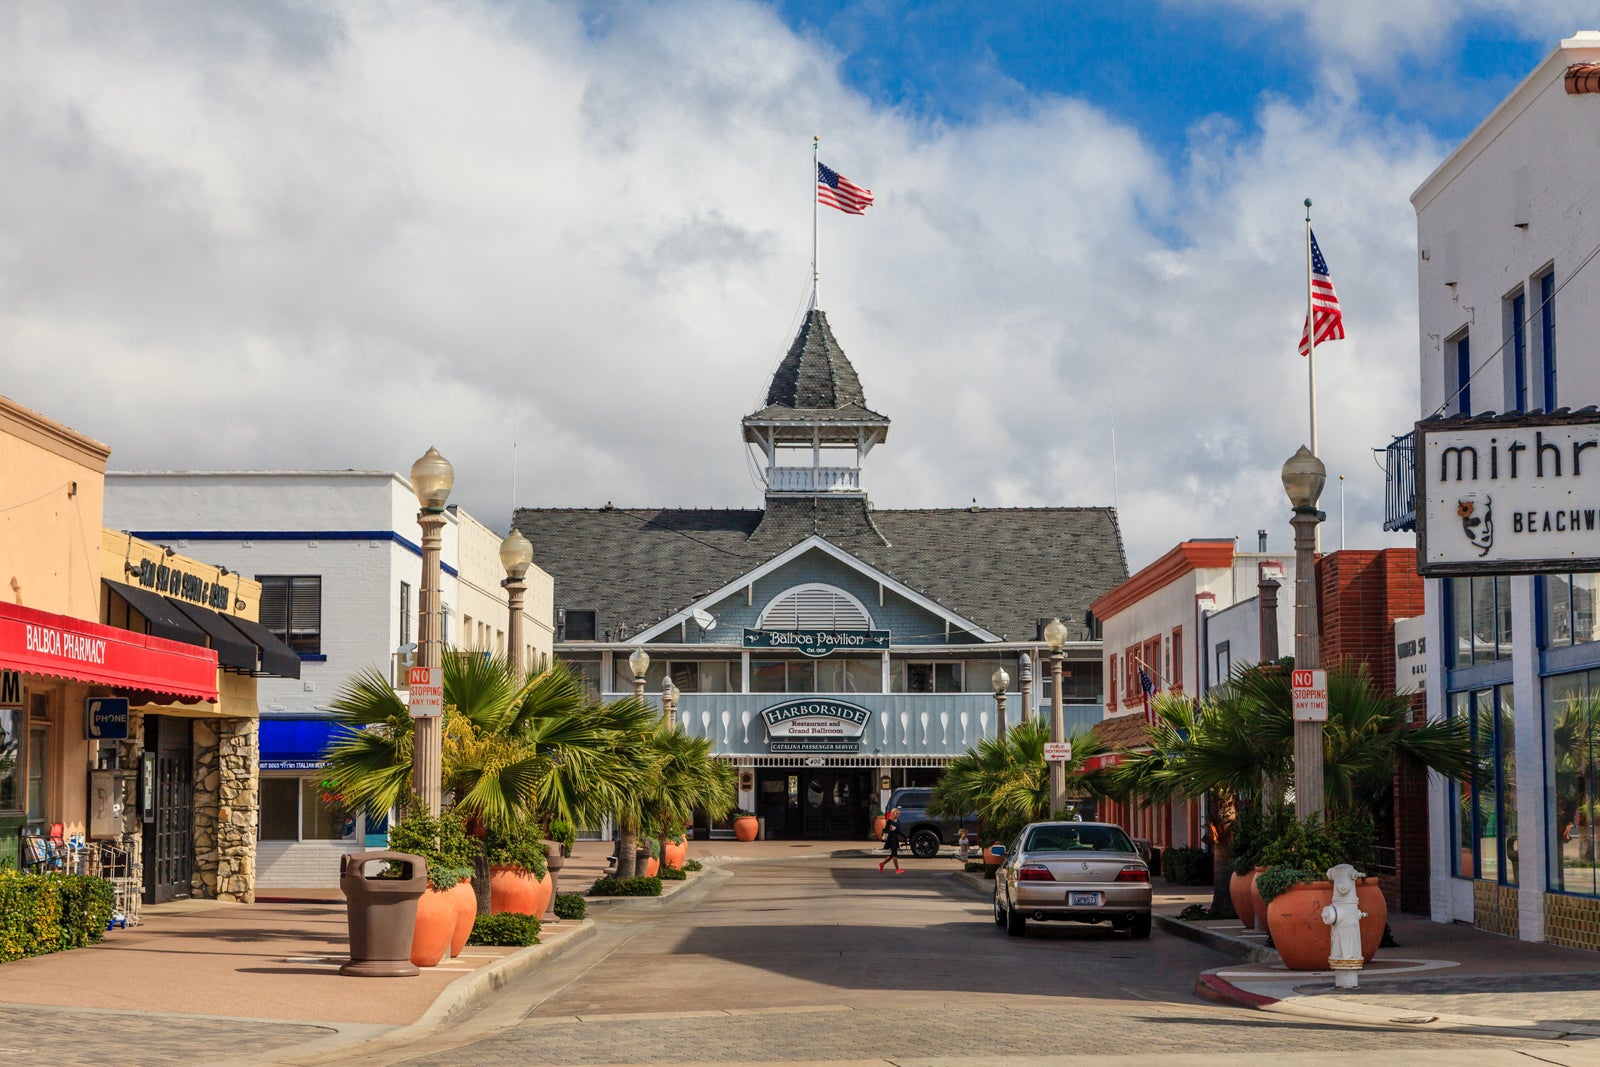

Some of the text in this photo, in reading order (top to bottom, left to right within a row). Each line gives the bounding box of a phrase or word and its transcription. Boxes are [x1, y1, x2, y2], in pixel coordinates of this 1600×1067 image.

[1440, 431, 1598, 481] mithr
[1513, 509, 1600, 533] BEACHW
[26, 625, 106, 664] BALBOA PHARMACY
[769, 631, 864, 647] Balboa Pavilion
[412, 669, 428, 683] NO
[1295, 672, 1311, 686] NO
[410, 686, 442, 696] STOPPING
[1294, 689, 1326, 700] STOPPING
[95, 714, 127, 723] PHONE
[768, 704, 865, 723] HARBORSIDE
